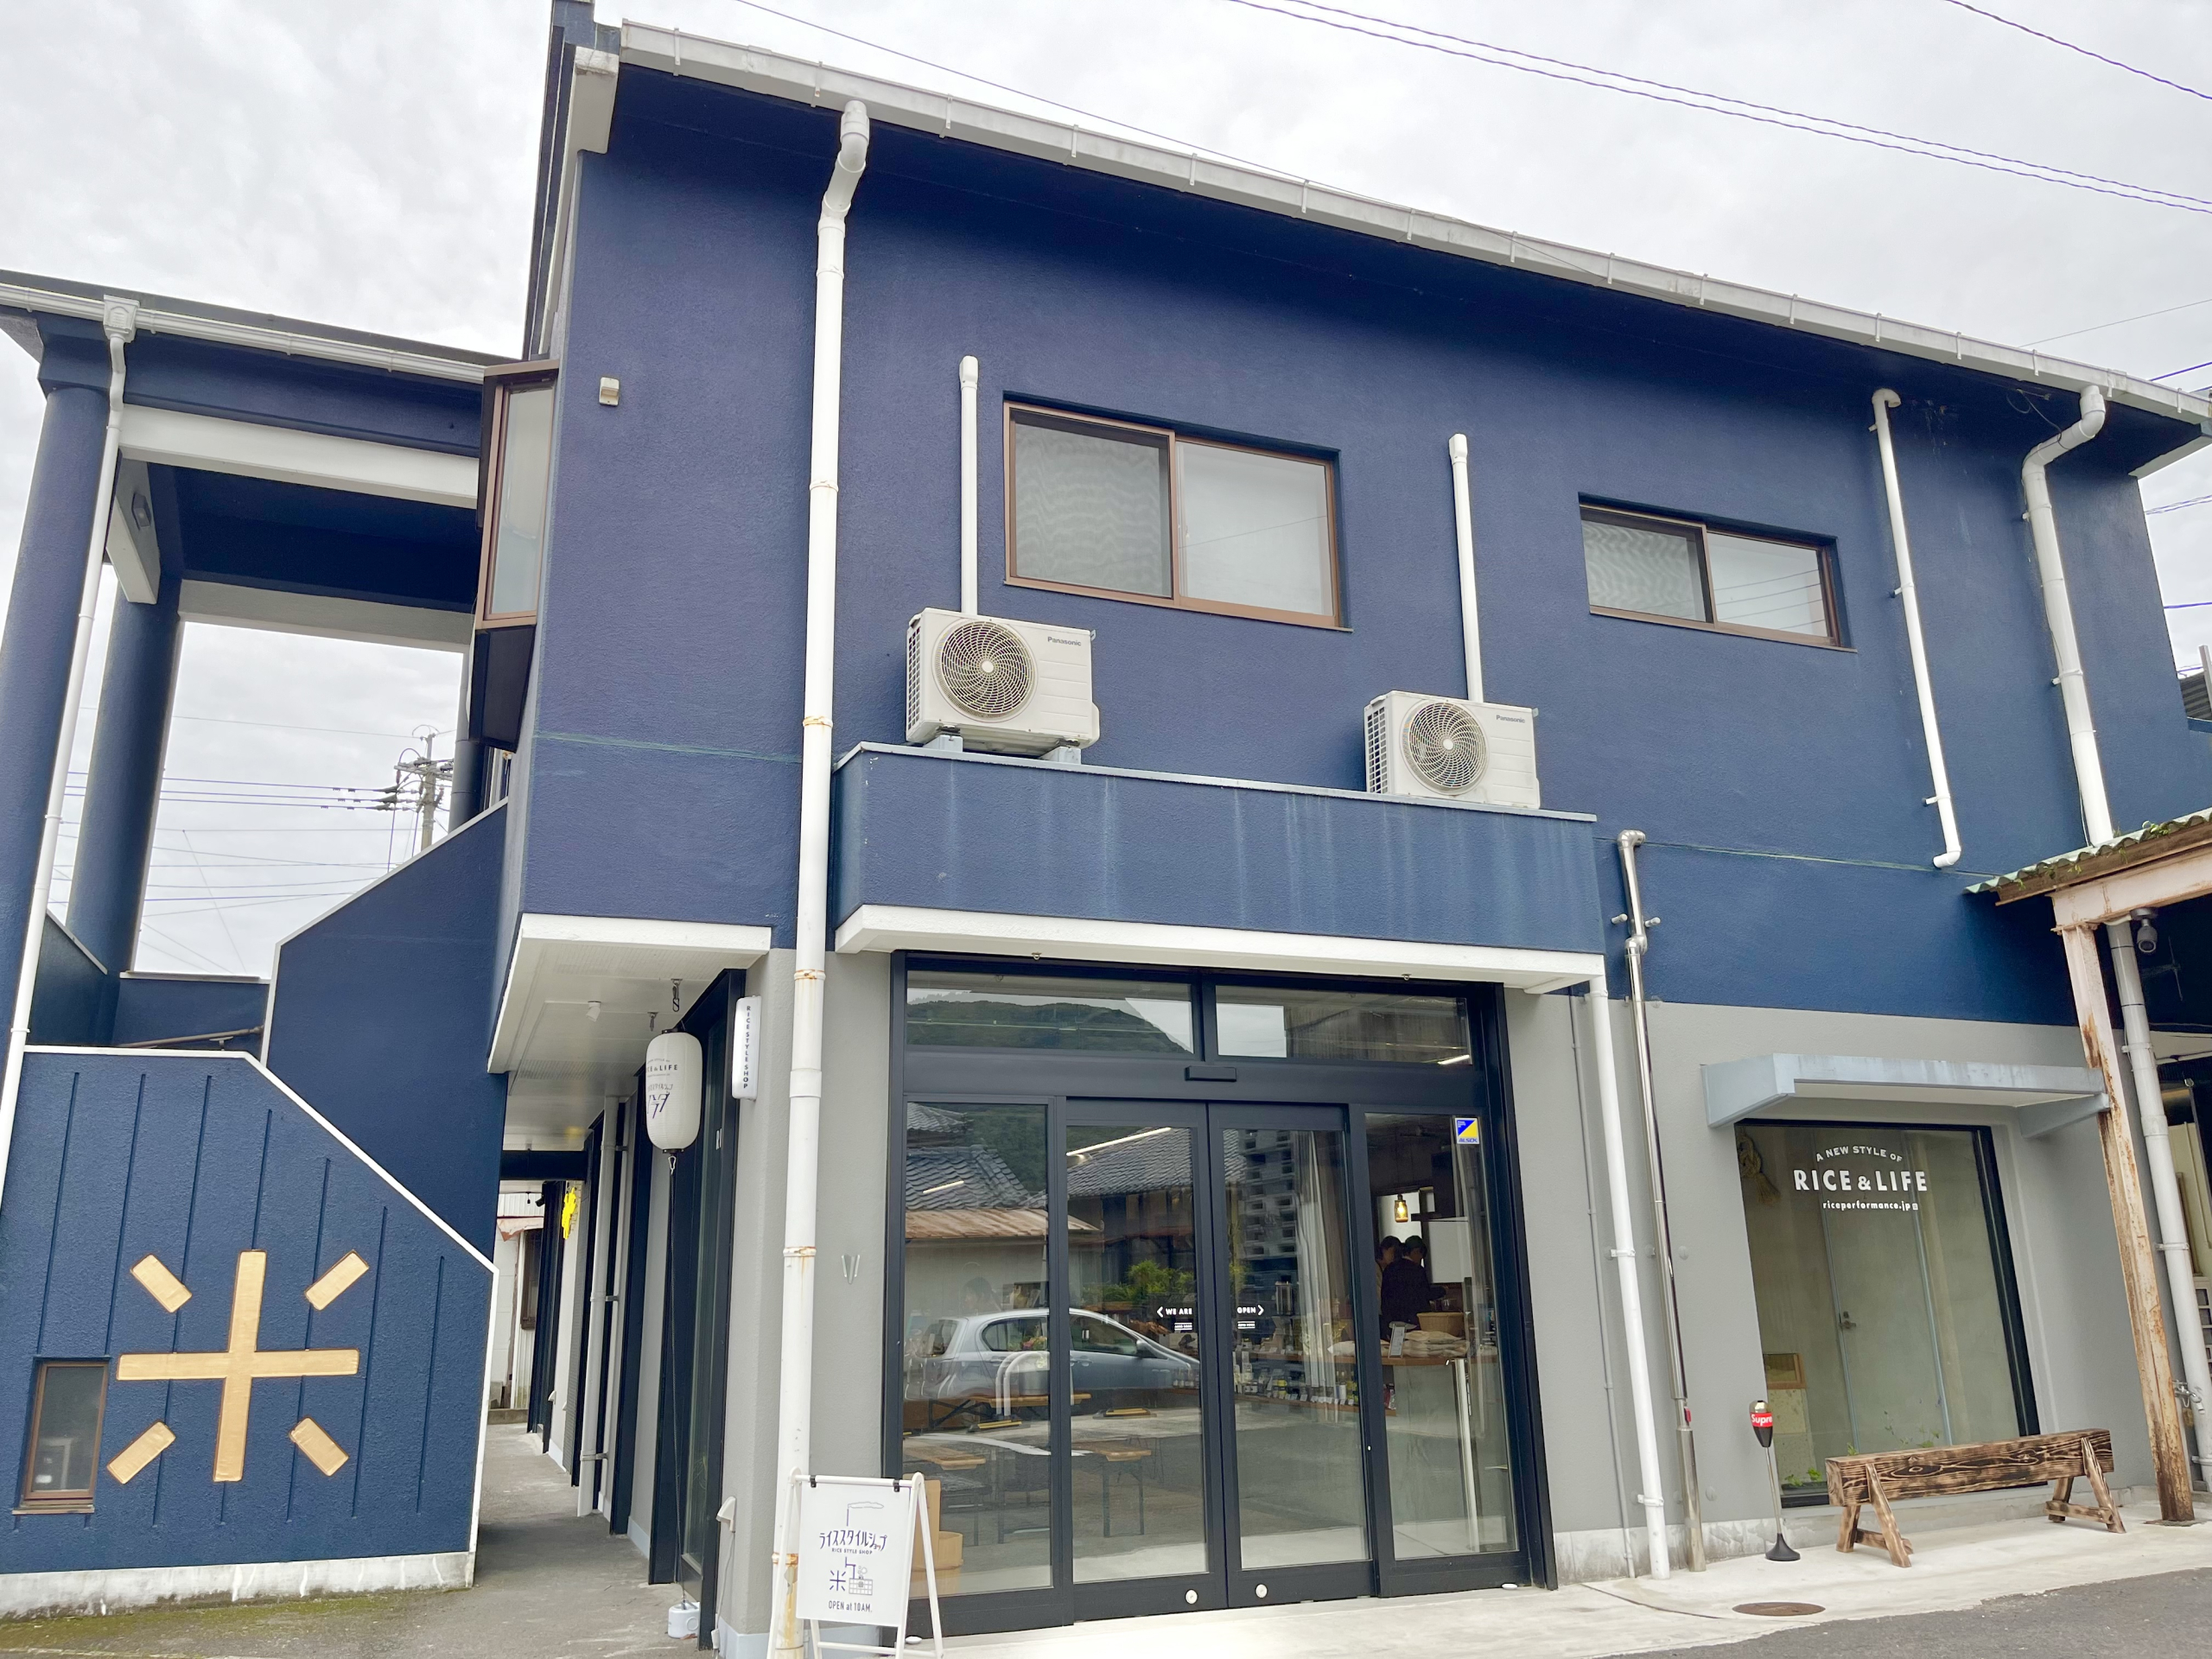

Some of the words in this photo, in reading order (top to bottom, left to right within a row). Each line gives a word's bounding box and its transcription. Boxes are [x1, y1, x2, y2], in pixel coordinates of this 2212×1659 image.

[1047, 636, 1082, 646] Panasonic
[1496, 715, 1526, 723] Panasonic
[1816, 1153, 1824, 1162] A
[1825, 1146, 1849, 1158] NEW
[1853, 1145, 1887, 1158] STYLE
[1890, 1153, 1903, 1163] OF
[1793, 1169, 1853, 1192] RICE
[1858, 1175, 1872, 1192] &
[1875, 1170, 1928, 1192] LIFE
[829, 1600, 844, 1610] OPEN
[846, 1602, 852, 1611] at
[854, 1602, 873, 1613] 10AM.
